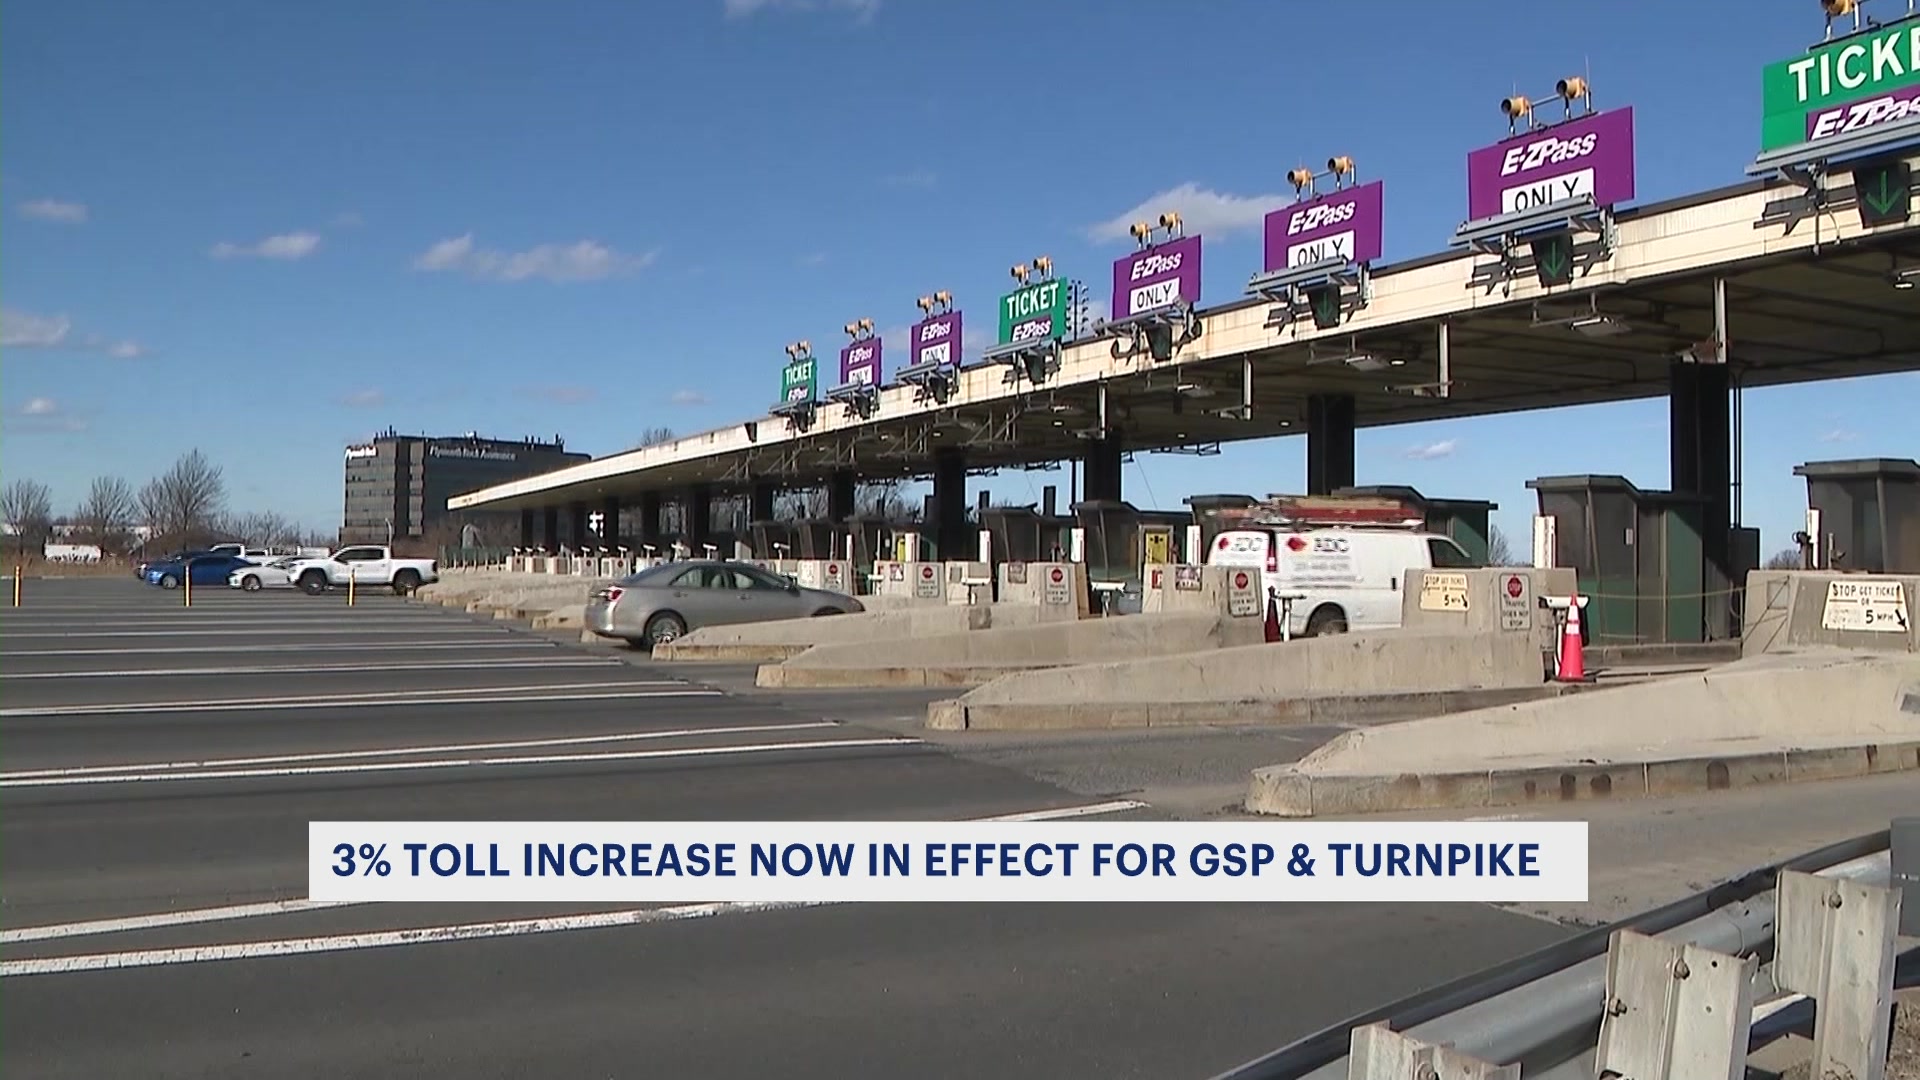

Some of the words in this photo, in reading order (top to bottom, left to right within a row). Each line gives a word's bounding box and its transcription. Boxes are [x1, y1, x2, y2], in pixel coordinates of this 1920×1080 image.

[1500, 133, 1598, 176] E-ZPass
[1287, 201, 1356, 236] E-ZPass
[1131, 252, 1182, 281] E-ZPass
[1007, 283, 1059, 319] TICKET
[1137, 283, 1172, 308] ONLY
[786, 361, 813, 386] TICKET
[1444, 594, 1450, 607] 5
[1832, 584, 1857, 597] STOP
[1859, 586, 1872, 596] GET
[1861, 598, 1870, 606] OR
[1865, 609, 1874, 624] 5
[1877, 613, 1894, 621] MPH
